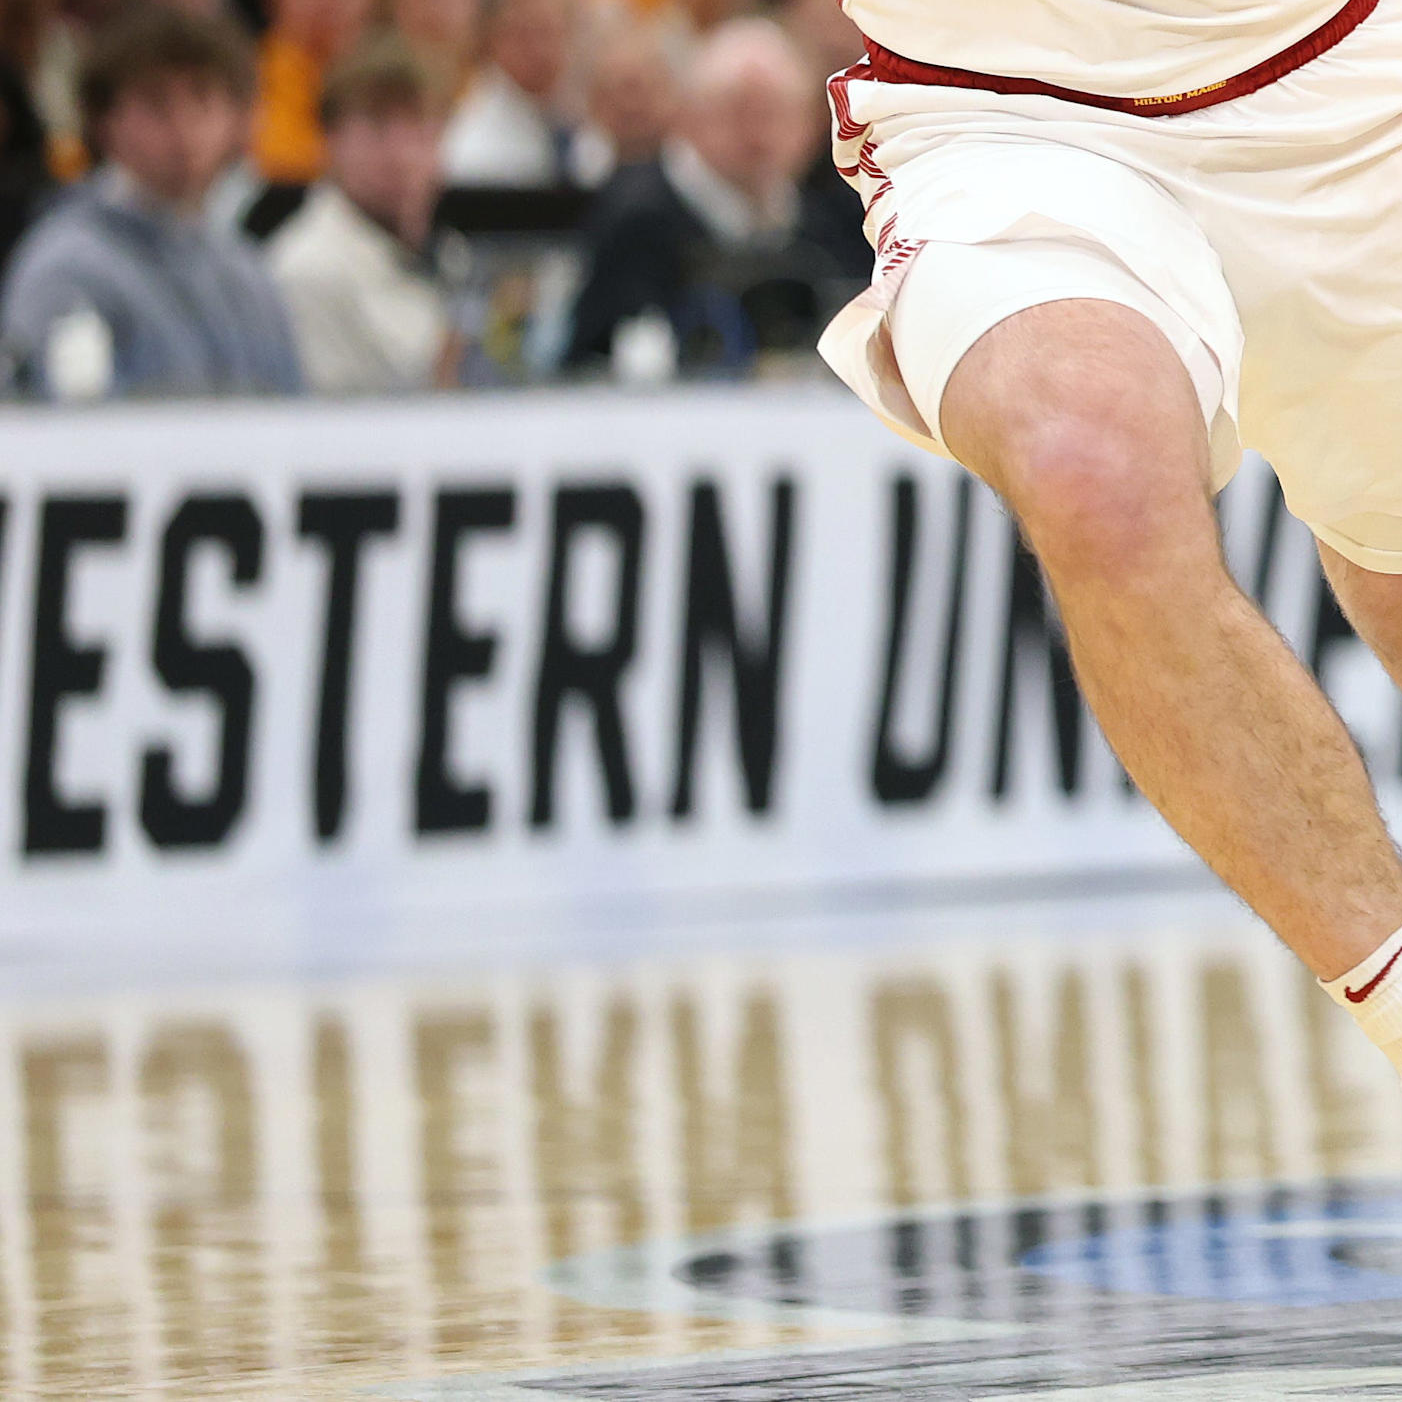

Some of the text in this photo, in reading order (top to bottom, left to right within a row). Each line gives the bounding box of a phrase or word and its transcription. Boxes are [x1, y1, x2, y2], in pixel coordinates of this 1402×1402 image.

[1133, 80, 1227, 107] HILTON MAGIC
[0, 478, 795, 856] ESTERN
